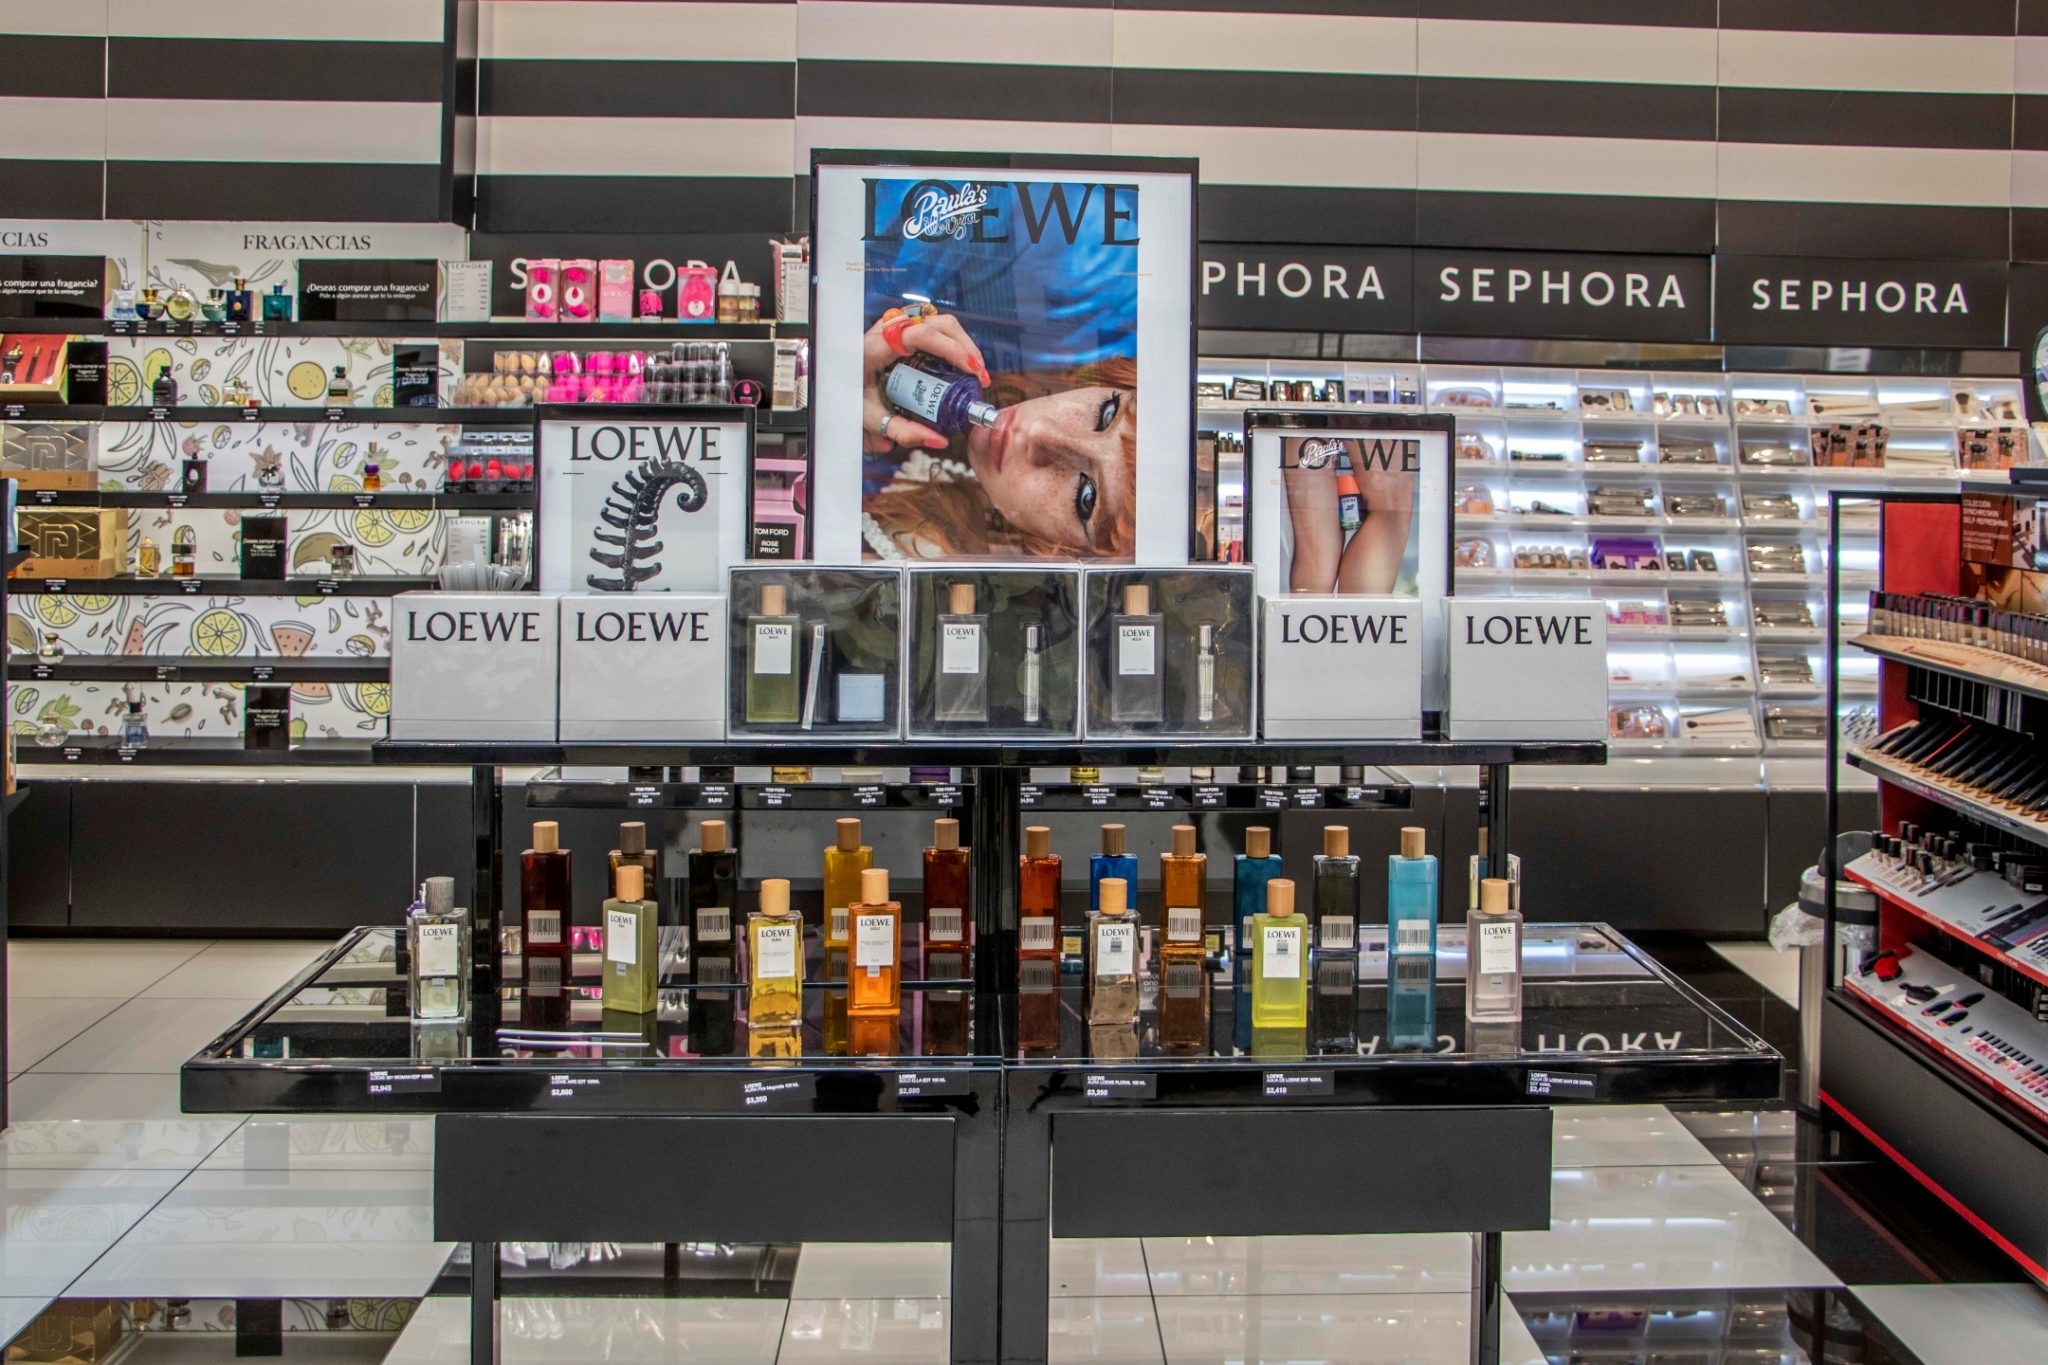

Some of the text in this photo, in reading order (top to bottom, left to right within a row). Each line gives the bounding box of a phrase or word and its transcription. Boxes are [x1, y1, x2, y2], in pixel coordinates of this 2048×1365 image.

[860, 178, 1140, 246] LOEWE
[903, 182, 987, 239] Paula's
[0, 231, 48, 247] CIAS
[243, 234, 371, 250] FRAGANCIAS
[4, 280, 38, 288] comprar
[57, 279, 98, 289] fragancia?
[1202, 260, 1385, 300] PHORA
[306, 283, 336, 293] ¿Deseas
[337, 284, 372, 293] comprar
[389, 283, 429, 293] fragancia?
[1440, 266, 1686, 309] SEPHORA
[1752, 278, 1968, 314] SEPHORA
[926, 382, 945, 418] LOEWE
[569, 426, 722, 461] LOEWE
[1278, 436, 1421, 472] LOEWE
[754, 527, 790, 536] TOM FORD
[407, 611, 540, 642] LOEWE
[576, 611, 709, 642] LOEWE
[758, 627, 789, 635] LOEWE
[946, 627, 976, 636] LOEWE
[1122, 628, 1152, 637] LOEWE
[1282, 614, 1408, 644] LOEWE
[1466, 615, 1592, 645] LOEWE
[610, 914, 633, 926] LOEWE
[860, 918, 891, 927] LOEWE
[423, 927, 454, 937] LOEWE
[760, 928, 792, 938] LOEWE
[1101, 928, 1132, 937] LOEWE
[1266, 930, 1297, 939] LOEWE
[1484, 926, 1513, 936] LOEWE
[1266, 1086, 1287, 1094] $2,410
[1529, 1086, 1550, 1094] $2,410
